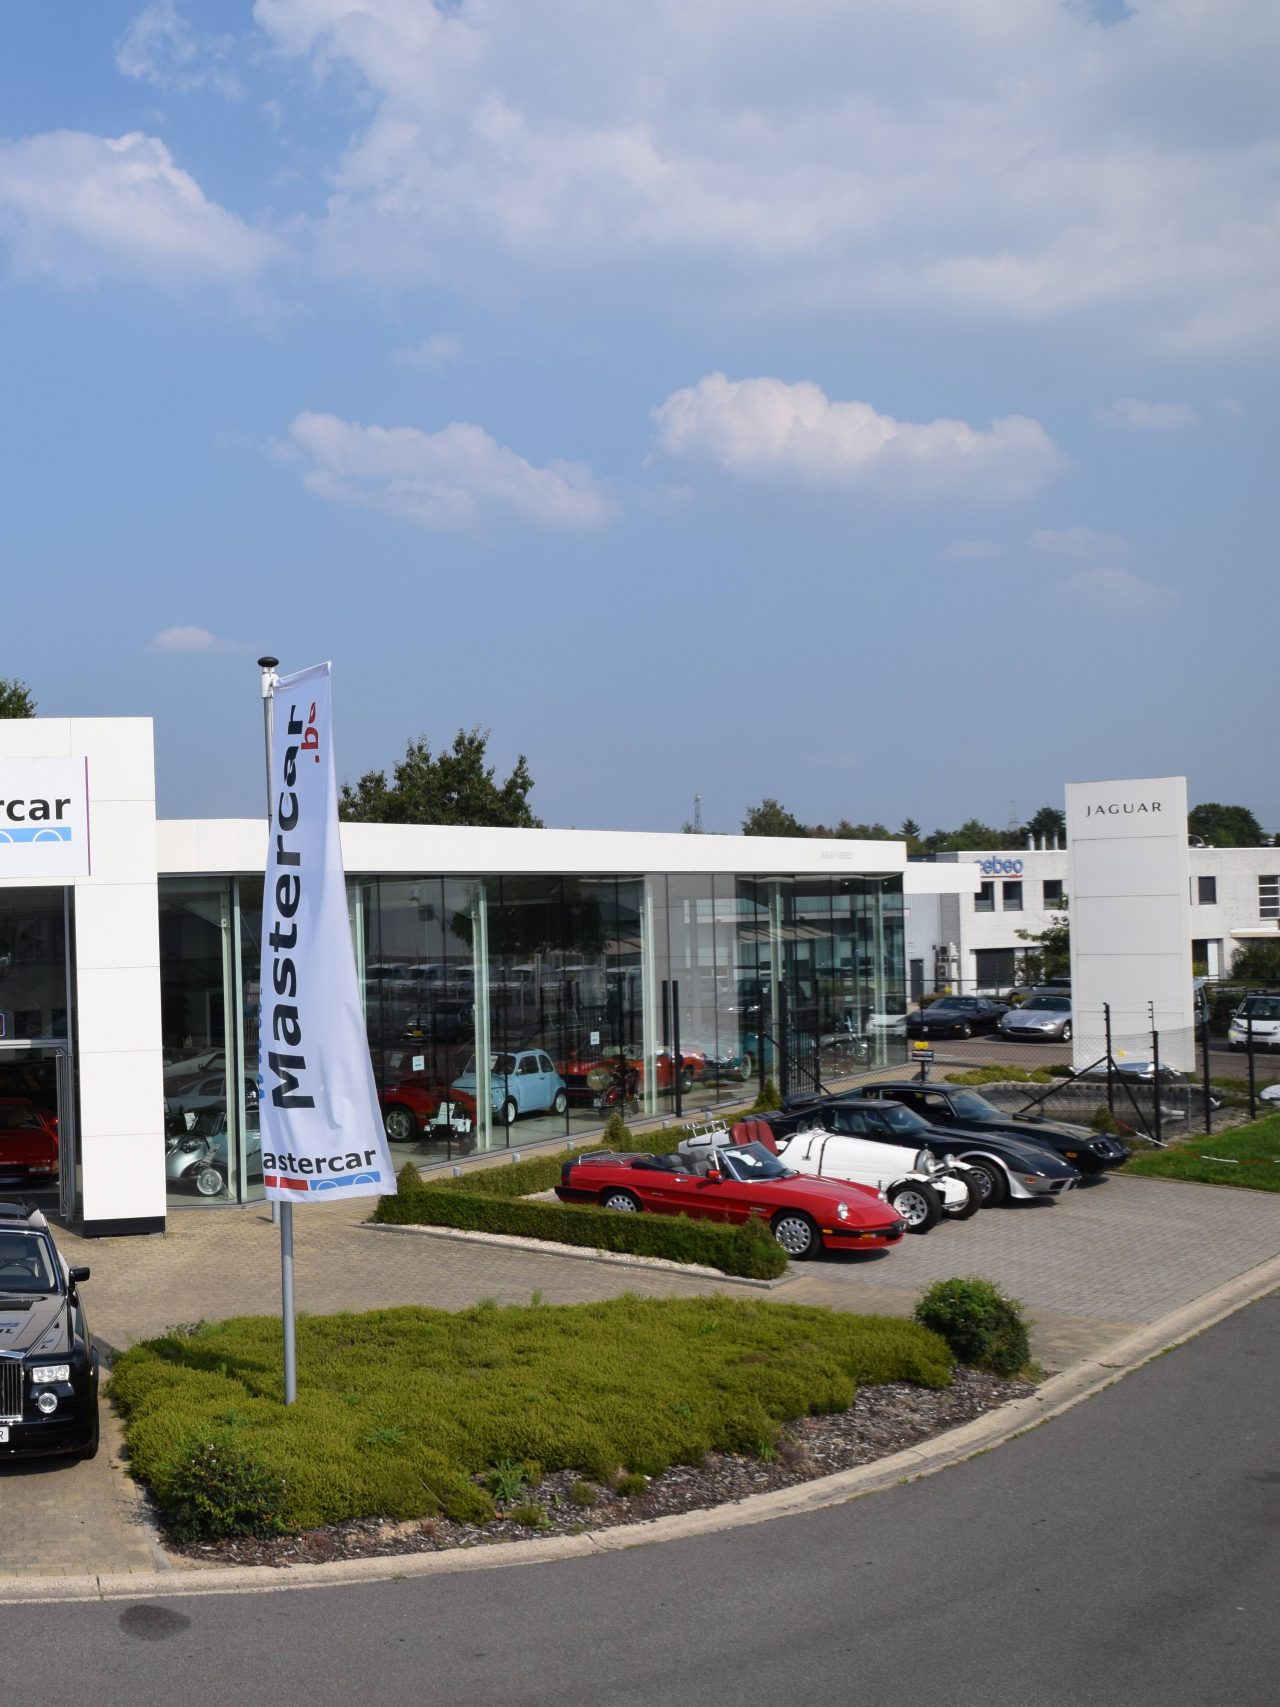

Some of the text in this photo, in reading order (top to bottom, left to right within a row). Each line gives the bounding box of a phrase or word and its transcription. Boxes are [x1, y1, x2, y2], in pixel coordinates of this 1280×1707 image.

[1086, 802, 1162, 818] JAGUAR
[268, 704, 316, 1109] Mastercar
[263, 1149, 377, 1174] astercar
